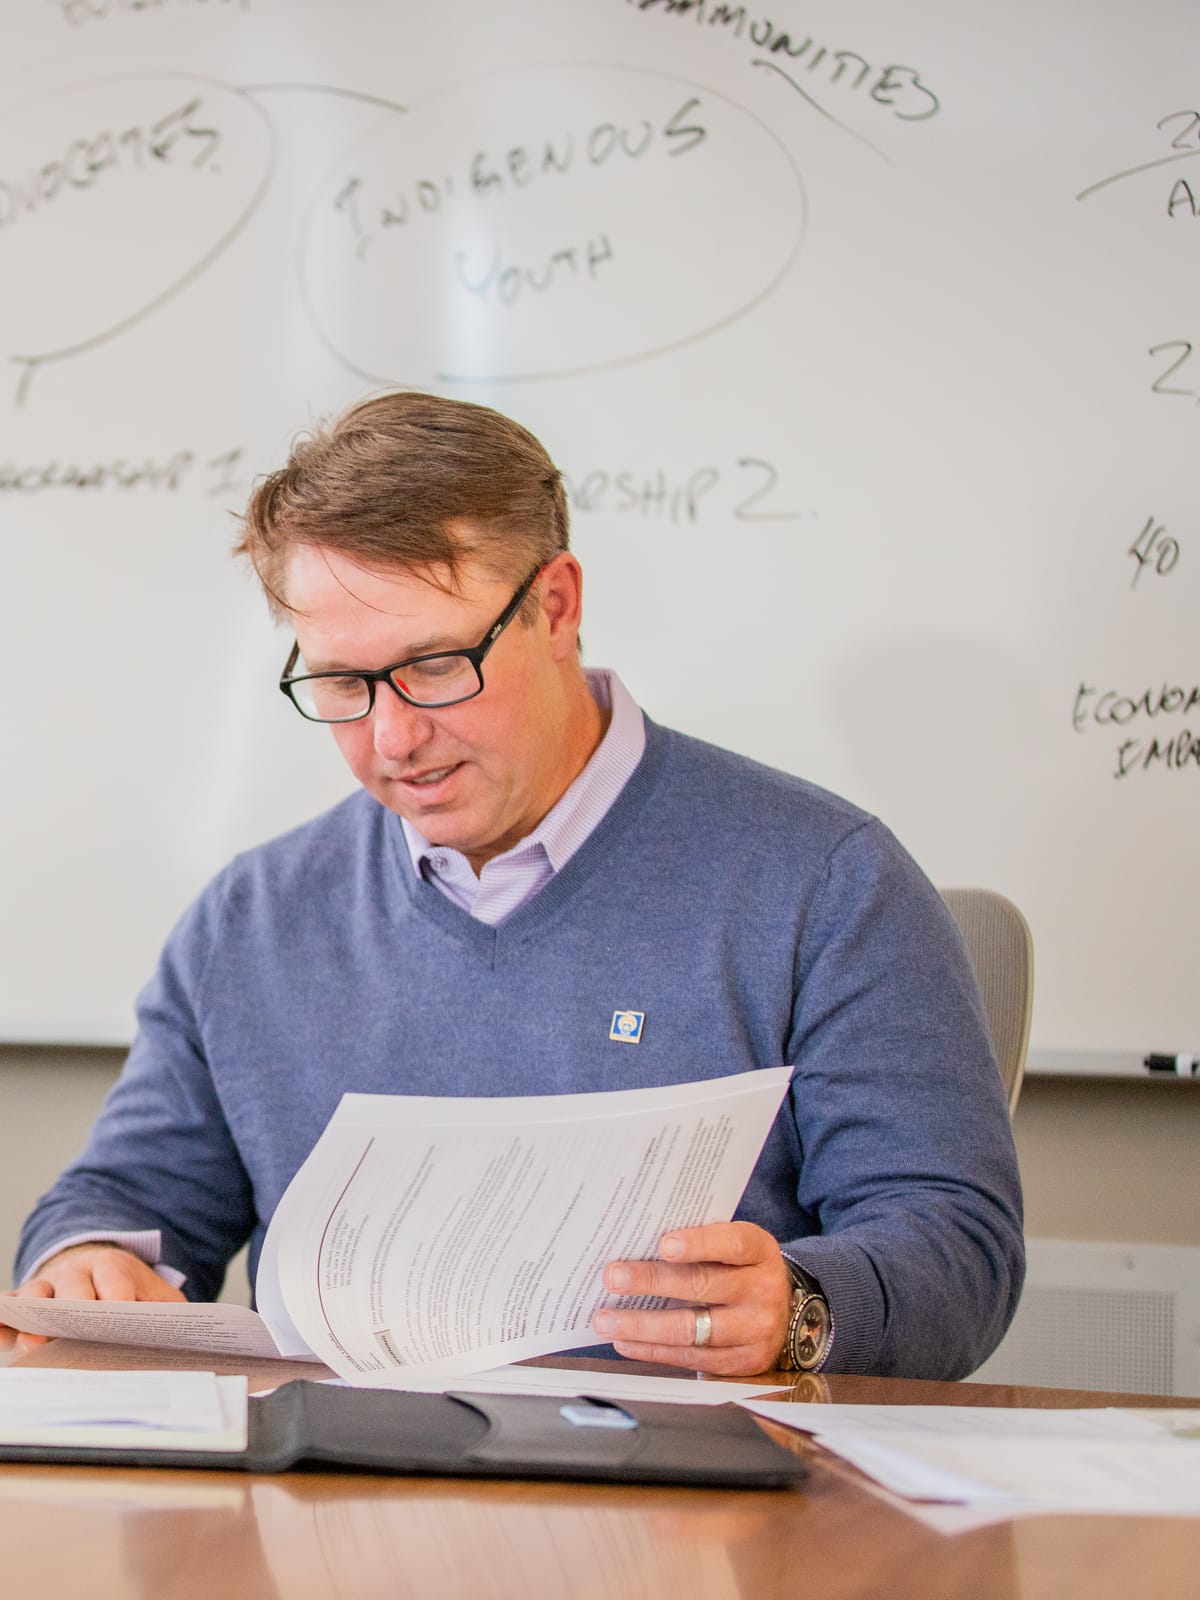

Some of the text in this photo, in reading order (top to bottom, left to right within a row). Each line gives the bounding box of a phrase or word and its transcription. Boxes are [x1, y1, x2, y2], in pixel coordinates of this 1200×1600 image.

[625, 0, 939, 120] MMUNITIES
[333, 97, 707, 260] INDIGENOUS
[455, 234, 615, 306] YOUTH
[1127, 515, 1180, 591] 40
